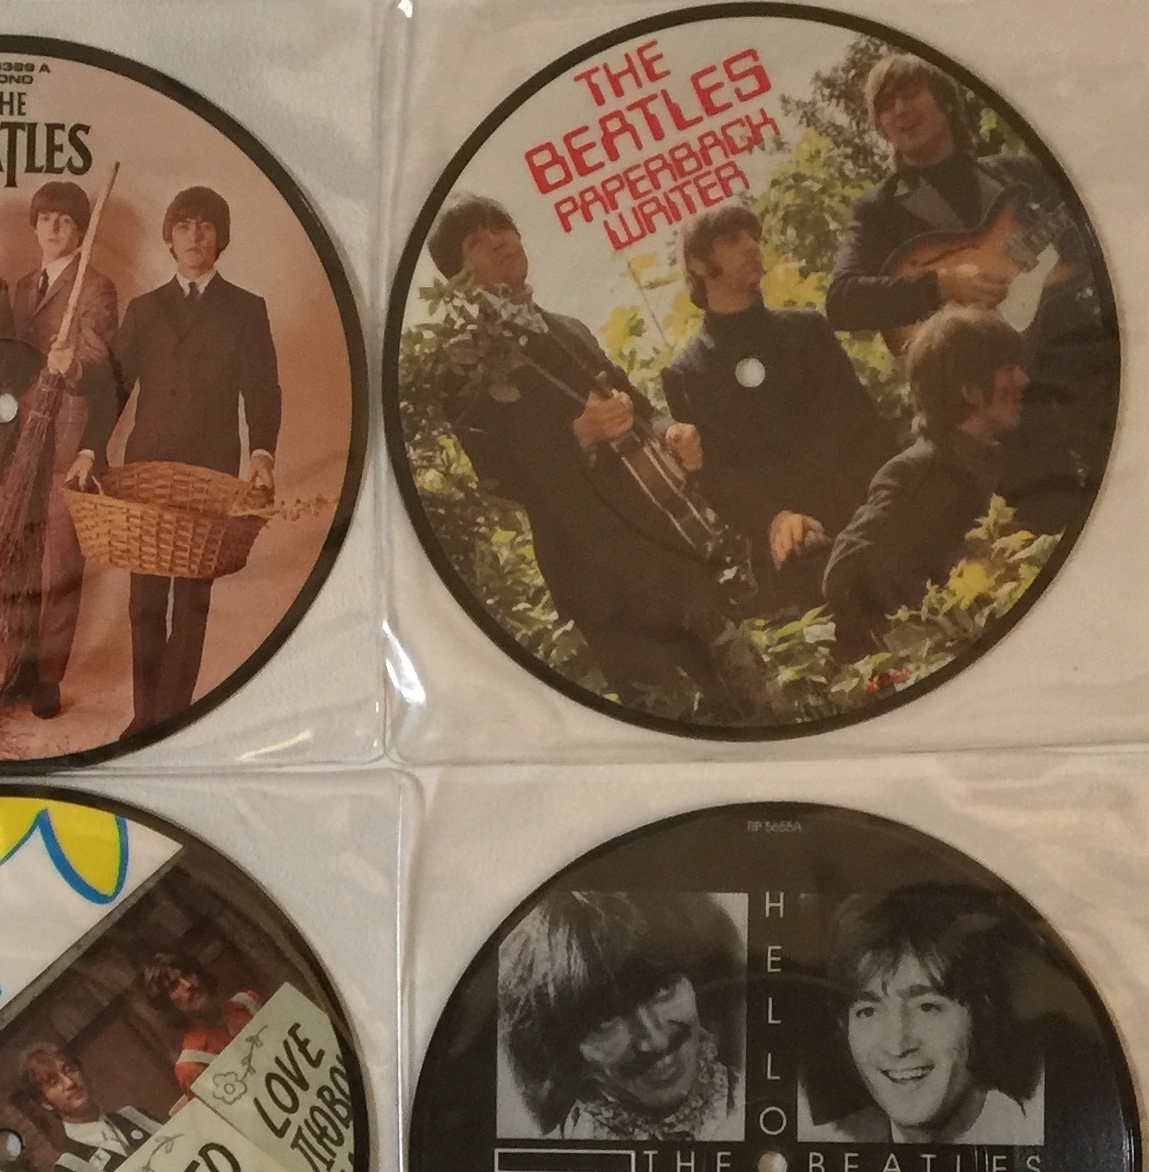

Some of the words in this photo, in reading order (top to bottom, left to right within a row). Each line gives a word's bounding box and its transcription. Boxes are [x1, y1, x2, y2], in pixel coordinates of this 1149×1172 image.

[38, 62, 51, 73] A
[524, 48, 772, 195] BEATLES
[573, 39, 671, 107] THE
[554, 107, 781, 233] PAPERBACK
[602, 160, 750, 251] WRITER
[759, 891, 787, 1136] HELLO
[253, 1023, 325, 1139] LOVE
